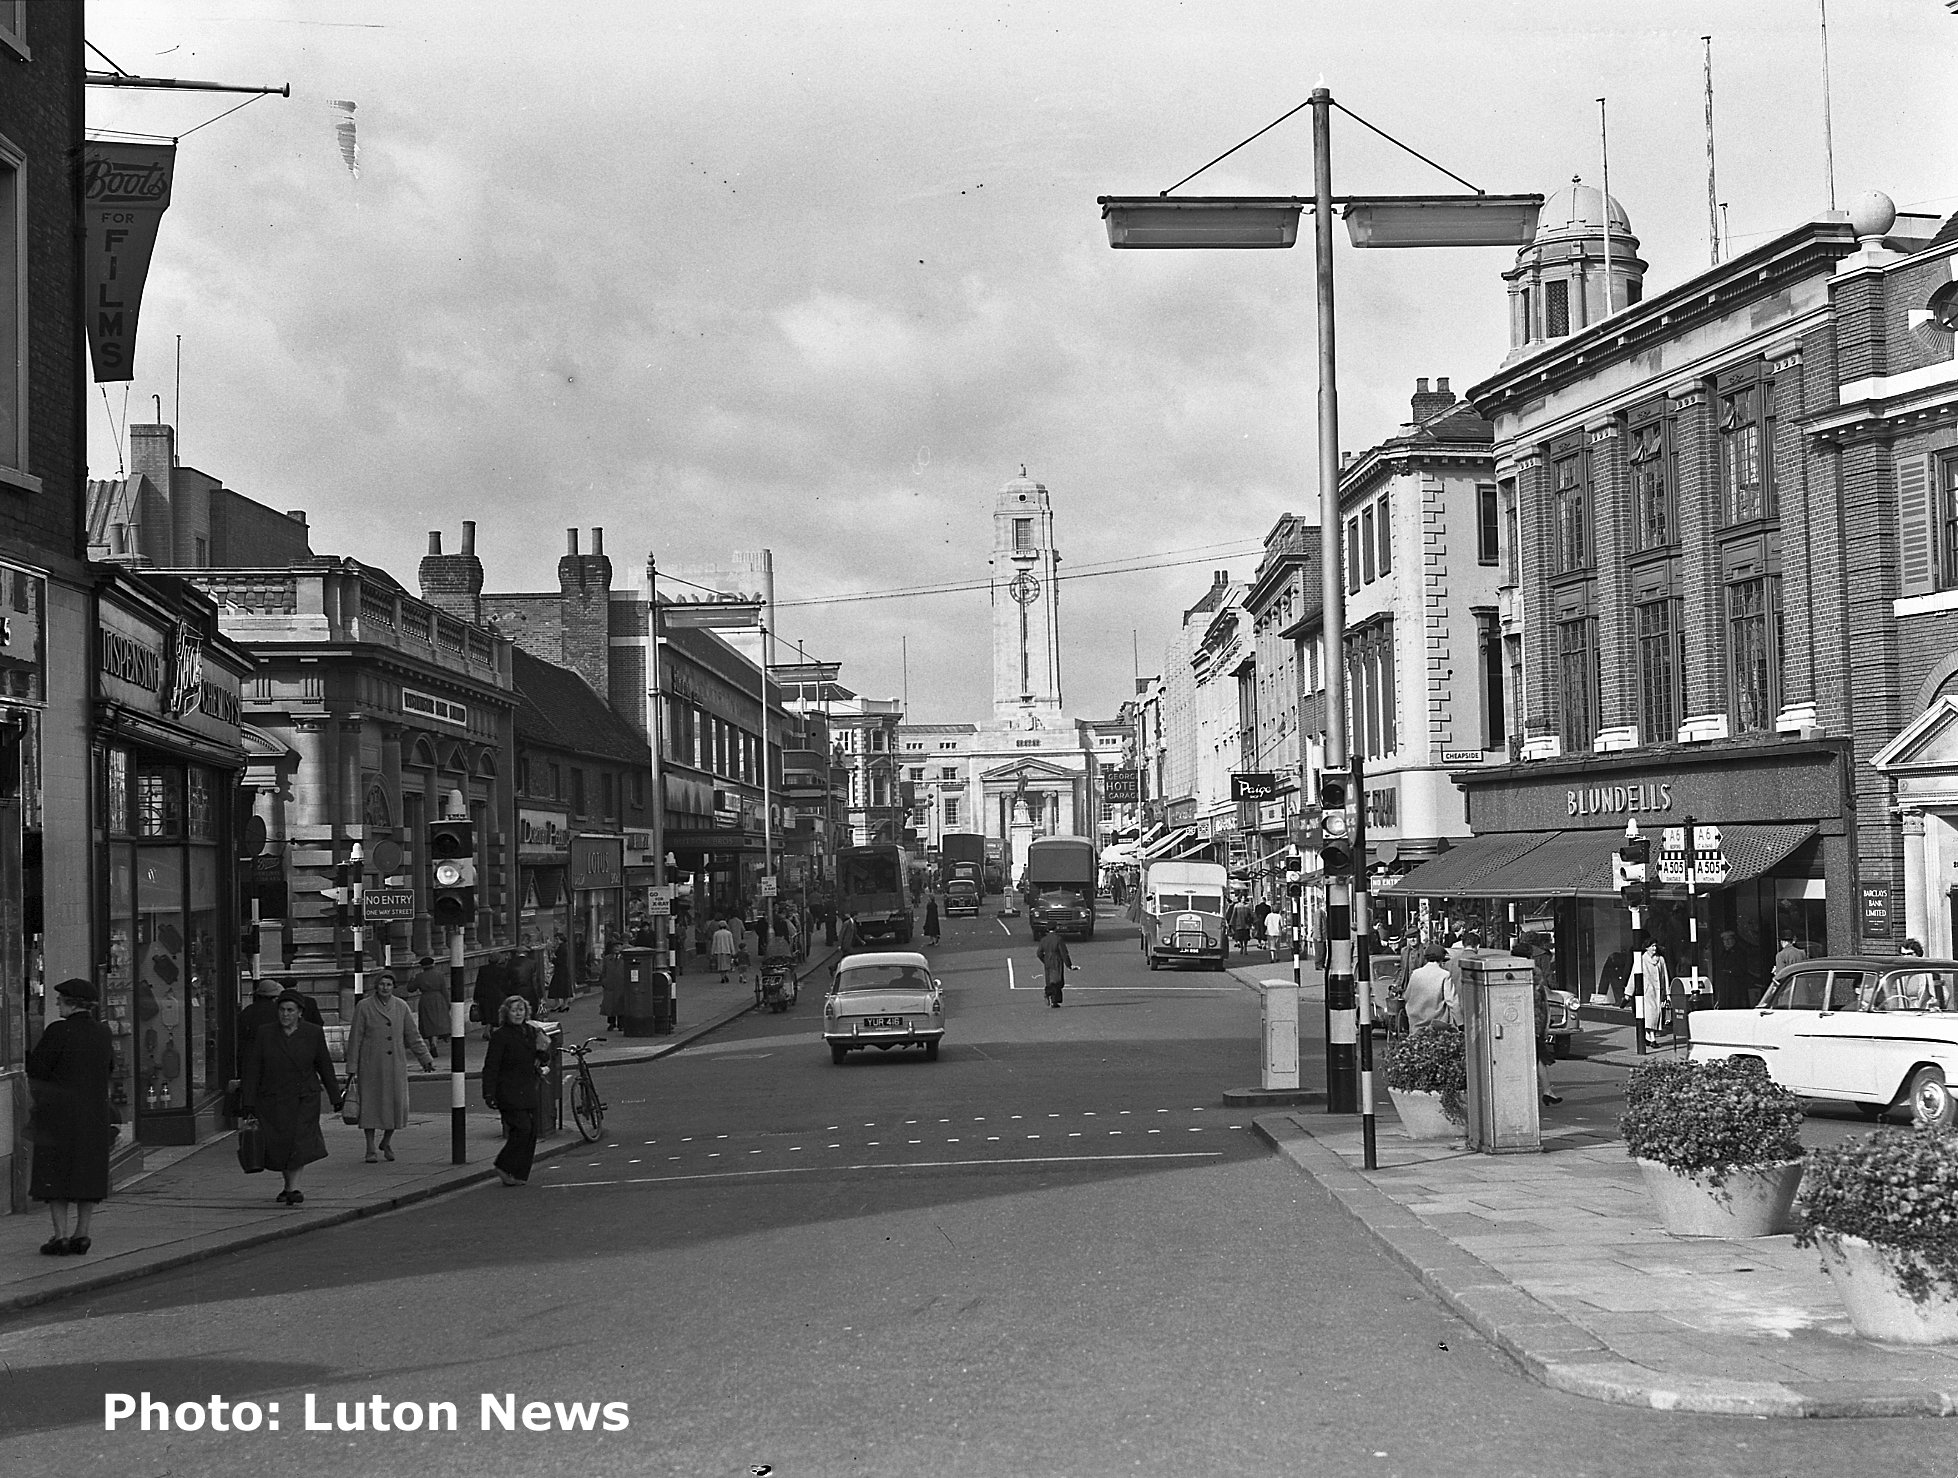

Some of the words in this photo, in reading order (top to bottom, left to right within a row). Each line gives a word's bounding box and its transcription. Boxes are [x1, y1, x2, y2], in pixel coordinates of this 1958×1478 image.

[85, 157, 168, 200] Boots
[101, 212, 135, 224] FOR
[99, 229, 129, 368] FILMS
[99, 627, 160, 693] DISPENSING
[200, 678, 240, 728] CHEMISTS
[1445, 752, 1479, 760] CHEAPSIDE
[1108, 772, 1138, 780] GEORG
[1106, 781, 1137, 791] HOTE
[1567, 783, 1673, 817] BLUNDELLS
[587, 851, 609, 874] LOTUS
[1663, 861, 1684, 874] A505
[1696, 861, 1721, 874] A505
[1863, 889, 1888, 897] BARCLAYS
[366, 895, 380, 905] NO
[381, 894, 413, 905] ENTRY
[1868, 899, 1883, 907] BANK
[1865, 909, 1887, 917] LIMITED
[867, 1017, 884, 1027] YUR
